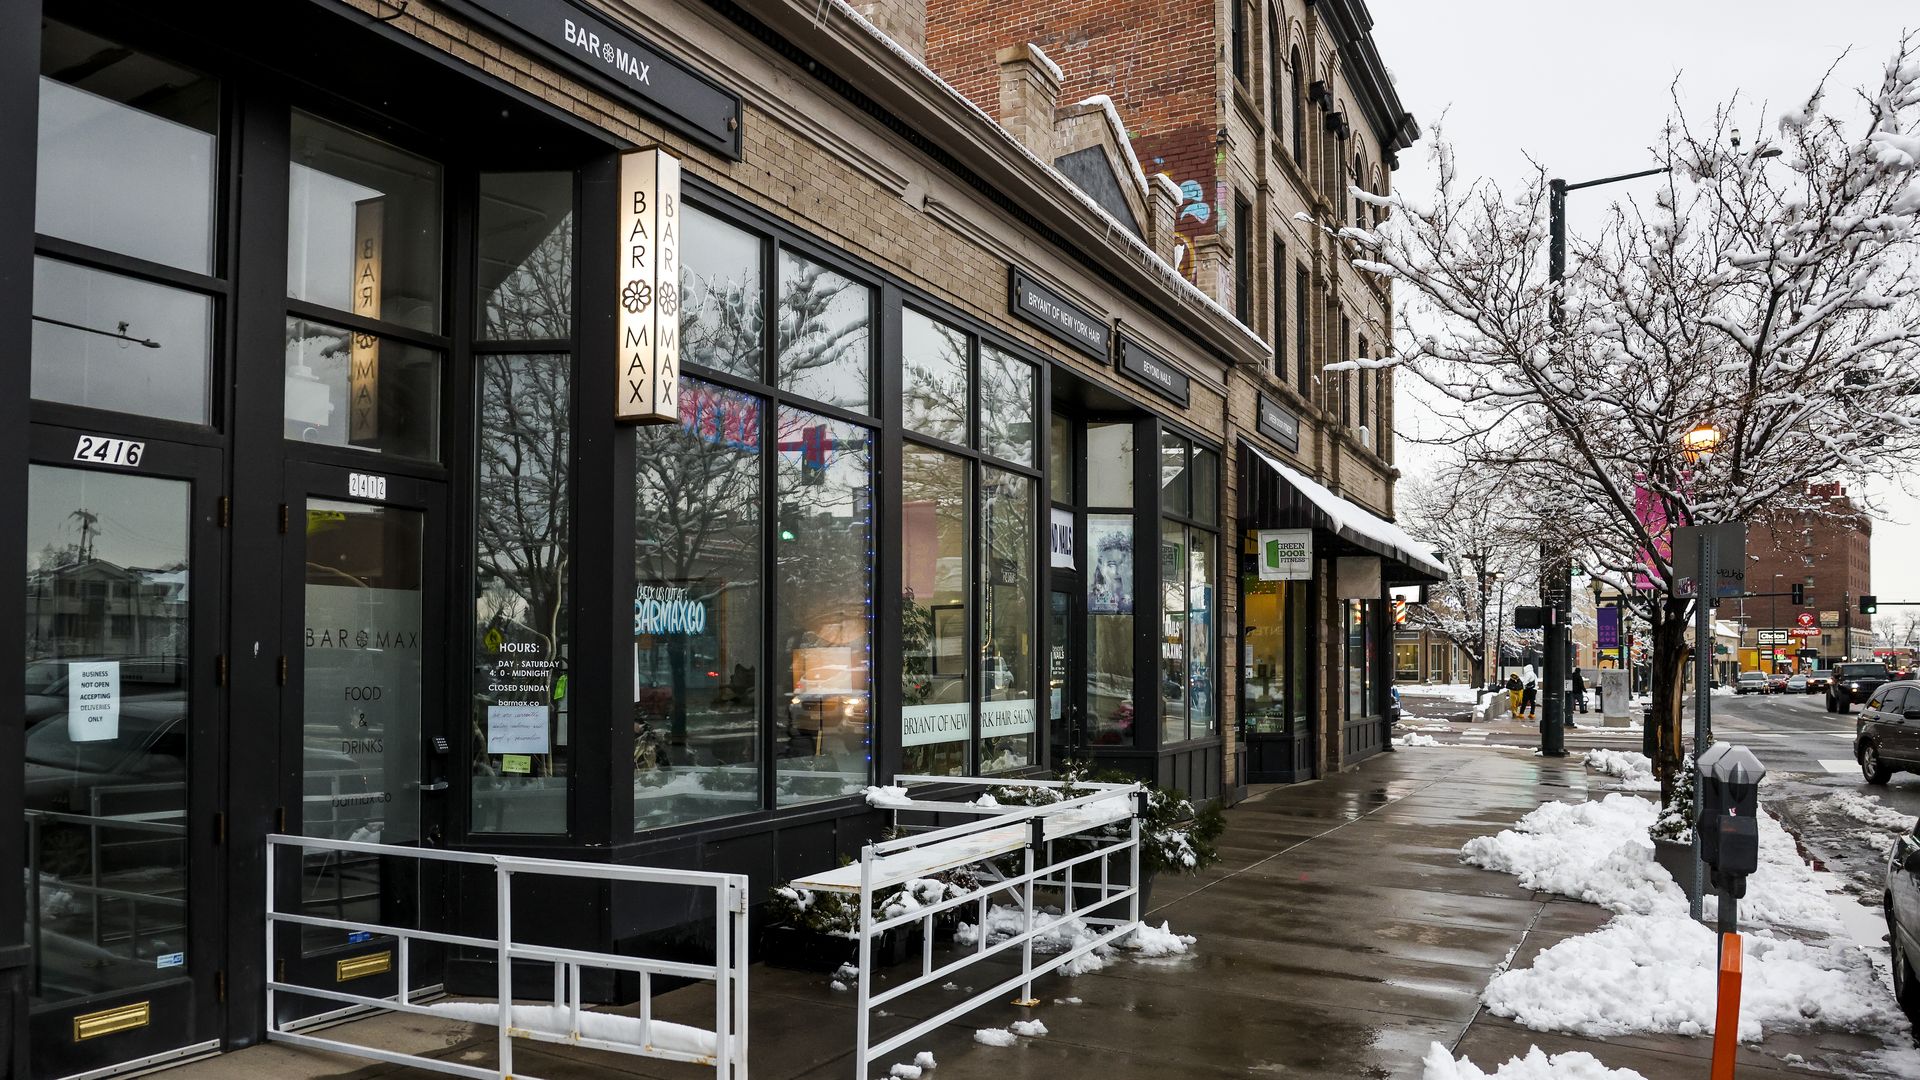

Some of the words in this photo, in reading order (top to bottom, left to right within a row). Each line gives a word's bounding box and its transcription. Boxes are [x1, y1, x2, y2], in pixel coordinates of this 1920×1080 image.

[565, 19, 600, 58] BAR
[616, 48, 650, 85] MAX
[630, 191, 647, 268] BAR
[664, 194, 674, 272] BAR
[1028, 292, 1051, 312] BRYANT
[1051, 307, 1060, 319] OF
[1060, 312, 1073, 327] NEW
[1073, 318, 1088, 336] YORK
[1088, 328, 1100, 345] HAIR
[626, 325, 648, 403] MAX
[661, 326, 675, 405] MAX
[1143, 360, 1160, 379] BEYOND
[1160, 370, 1172, 386] NAILS
[77, 438, 141, 464] 2416
[352, 478, 384, 495] 2412
[1059, 525, 1072, 556] NAILS
[306, 628, 348, 648] BAR
[376, 631, 418, 649] MAX
[500, 643, 540, 653] HOURS:
[345, 687, 382, 701] FOOD
[488, 684, 518, 692] CLOSED
[519, 684, 550, 692] SUNDAY
[498, 699, 540, 707] barmax.co
[359, 713, 367, 728] &
[903, 715, 936, 735] BRYANT
[938, 715, 949, 732] OF
[950, 713, 969, 731] NEW
[995, 710, 1012, 727] HAIR
[1014, 708, 1034, 725] SALON
[341, 739, 383, 755] DRINKS
